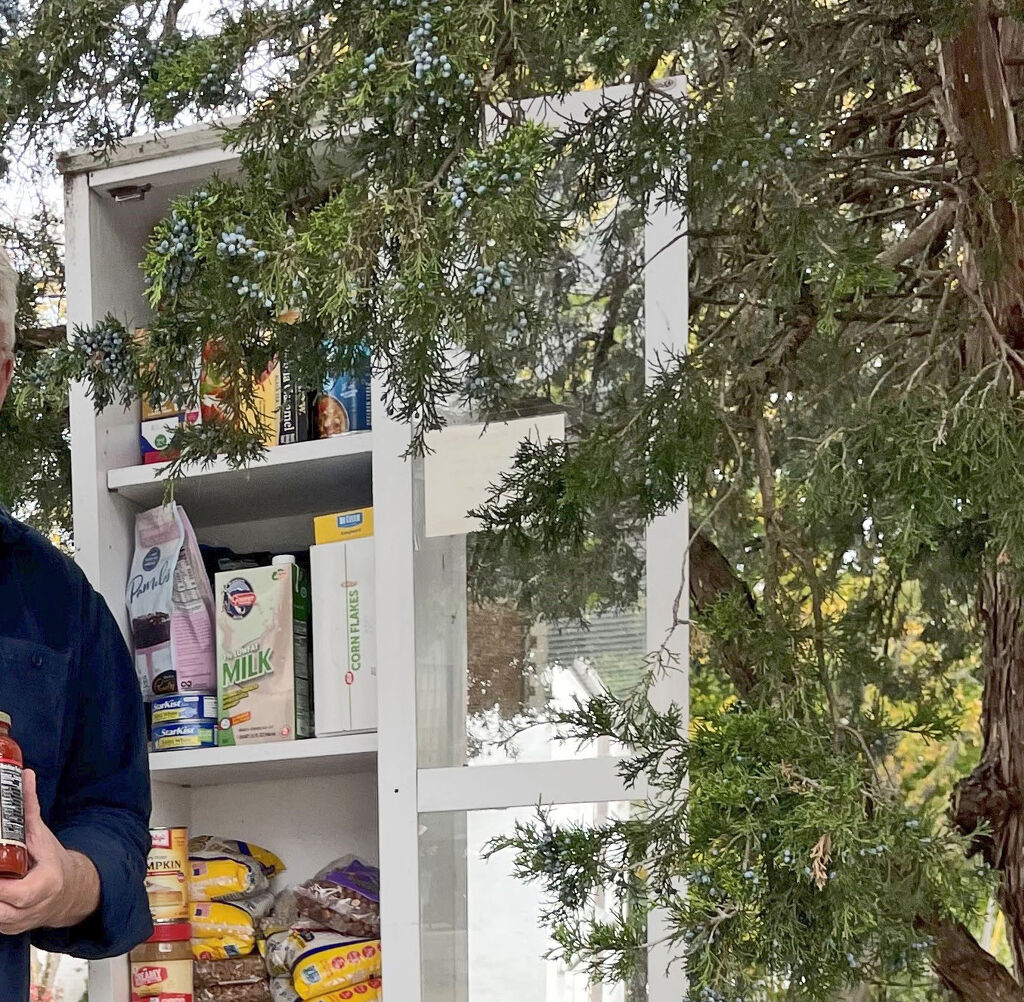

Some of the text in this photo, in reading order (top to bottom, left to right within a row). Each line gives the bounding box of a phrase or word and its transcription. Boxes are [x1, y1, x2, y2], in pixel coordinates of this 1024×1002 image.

[349, 589, 360, 634] FLAKES
[222, 648, 273, 687] MILK
[350, 636, 361, 671] CORN
[161, 726, 196, 737] StarKist
[147, 859, 182, 870] MPKIN
